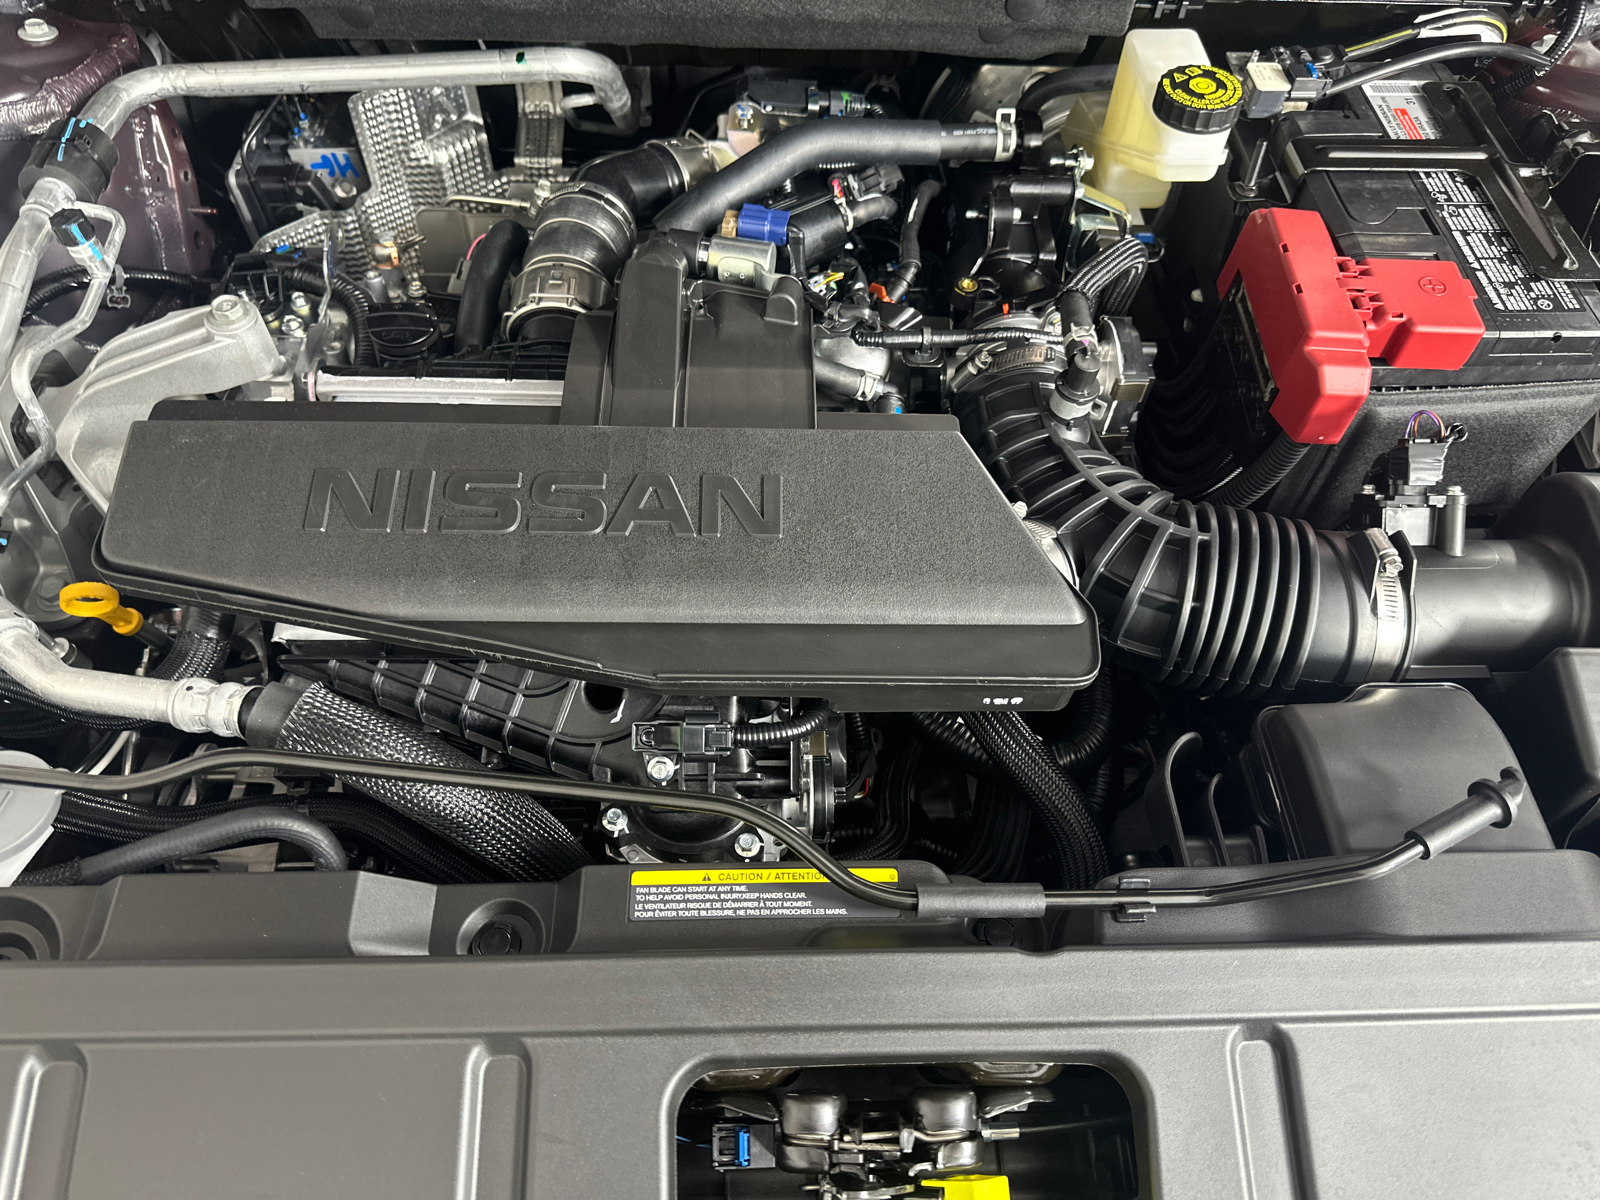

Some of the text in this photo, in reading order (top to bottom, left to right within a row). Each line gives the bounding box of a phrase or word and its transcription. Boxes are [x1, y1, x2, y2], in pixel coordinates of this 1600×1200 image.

[1404, 97, 1416, 105] 31
[1376, 104, 1393, 124] NISSAN
[304, 467, 784, 539] NISSAN
[718, 873, 763, 881] CAUTION
[723, 900, 758, 908] DÉMARRER
[655, 909, 677, 917] ÉVITER
